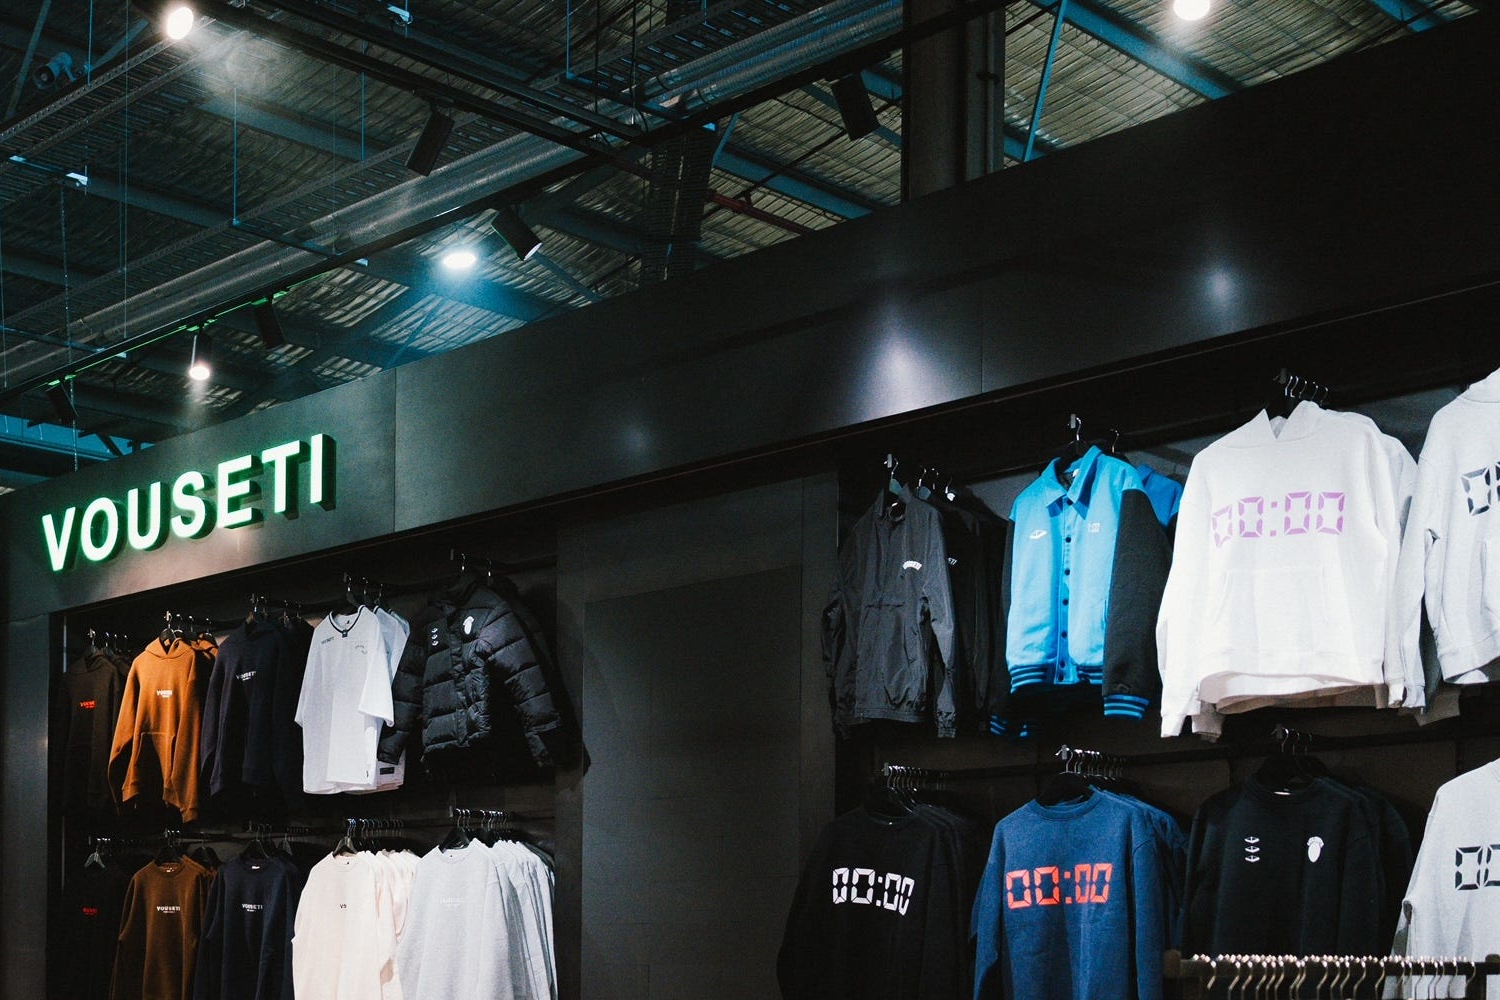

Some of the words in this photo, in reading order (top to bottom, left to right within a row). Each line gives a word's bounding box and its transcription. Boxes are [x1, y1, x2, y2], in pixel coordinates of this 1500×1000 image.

[41, 433, 328, 572] VOUSETI
[1212, 490, 1345, 548] 00:00
[832, 867, 915, 916] 00:00
[1005, 863, 1113, 910] 00:00
